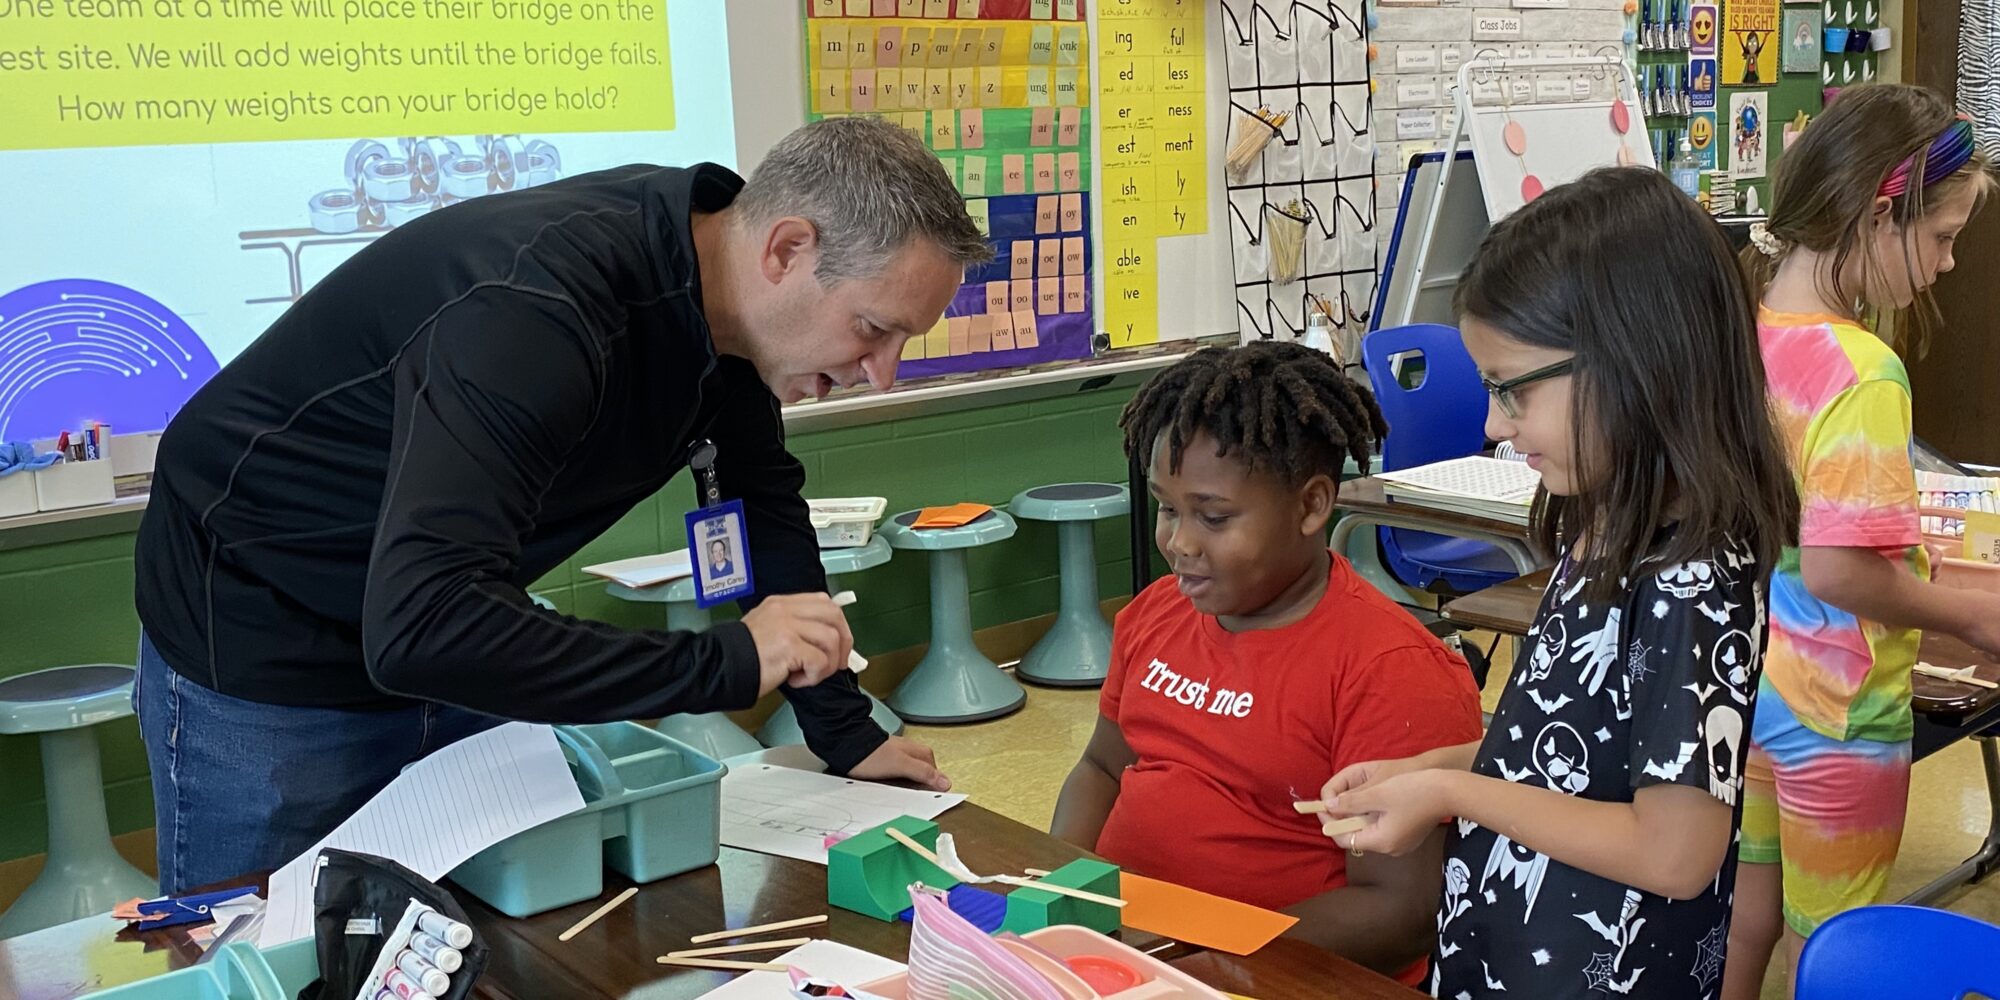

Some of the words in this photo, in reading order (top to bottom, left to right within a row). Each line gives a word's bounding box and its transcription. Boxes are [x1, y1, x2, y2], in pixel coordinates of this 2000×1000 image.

[65, 0, 143, 18] team
[154, 0, 185, 18] at
[194, 1, 212, 18] a
[221, 0, 283, 18] time
[344, 0, 415, 24] place
[425, 0, 483, 19] their
[492, 0, 572, 25] bridge
[580, 2, 609, 20] on
[617, 0, 654, 20] the
[1480, 20, 1499, 30] Class
[1500, 20, 1517, 30] Jobs
[1730, 14, 1739, 29] IS
[1743, 14, 1774, 29] RIGHT
[1115, 31, 1132, 51] ing
[1170, 27, 1185, 46] ful
[827, 41, 841, 52] m
[856, 42, 865, 52] n
[885, 40, 893, 51] o
[911, 42, 920, 55] p
[936, 44, 948, 55] qu
[964, 42, 971, 52] r
[988, 42, 996, 51] s
[1033, 42, 1050, 54] ong
[1060, 40, 1077, 51] onk
[58, 44, 120, 69] site.
[127, 43, 170, 68] We
[179, 42, 226, 67] will
[235, 42, 290, 67] add
[299, 41, 402, 72] weights
[410, 41, 469, 66] until
[474, 42, 516, 65] the
[524, 42, 603, 70] bridge
[609, 42, 662, 65] fails.
[1119, 62, 1134, 80] ed
[1168, 62, 1189, 80] less
[830, 85, 835, 97] t
[859, 86, 867, 95] u
[884, 84, 892, 94] v
[907, 83, 918, 94] w
[932, 84, 941, 95] x
[958, 82, 966, 97] y
[987, 83, 994, 93] z
[1030, 83, 1047, 95] ung
[1058, 81, 1075, 92] unk
[58, 95, 125, 121] How
[136, 98, 216, 124] many
[225, 91, 332, 122] weights
[341, 95, 390, 114] can
[398, 93, 456, 119] your
[465, 88, 547, 116] bridge
[555, 86, 618, 110] hold?
[1118, 107, 1132, 118] er
[1168, 105, 1192, 117] ness
[938, 125, 950, 136] ck
[968, 124, 975, 137] y
[1064, 124, 1075, 135] ay
[1117, 134, 1136, 153] est
[1165, 132, 1193, 152] ment
[1121, 176, 1137, 196] ish
[1176, 169, 1186, 196] ly
[1066, 209, 1076, 220] oy
[1173, 205, 1186, 230] ty
[1122, 215, 1137, 226] en
[1067, 253, 1080, 262] ow
[1116, 247, 1141, 267] able
[1016, 295, 1028, 303] oo
[1123, 288, 1140, 300] ive
[991, 297, 1003, 306] ou
[995, 327, 1009, 337] aw
[1019, 326, 1032, 336] au
[1126, 323, 1134, 342] y
[1140, 657, 1210, 710] Trust
[1207, 687, 1254, 718] me
